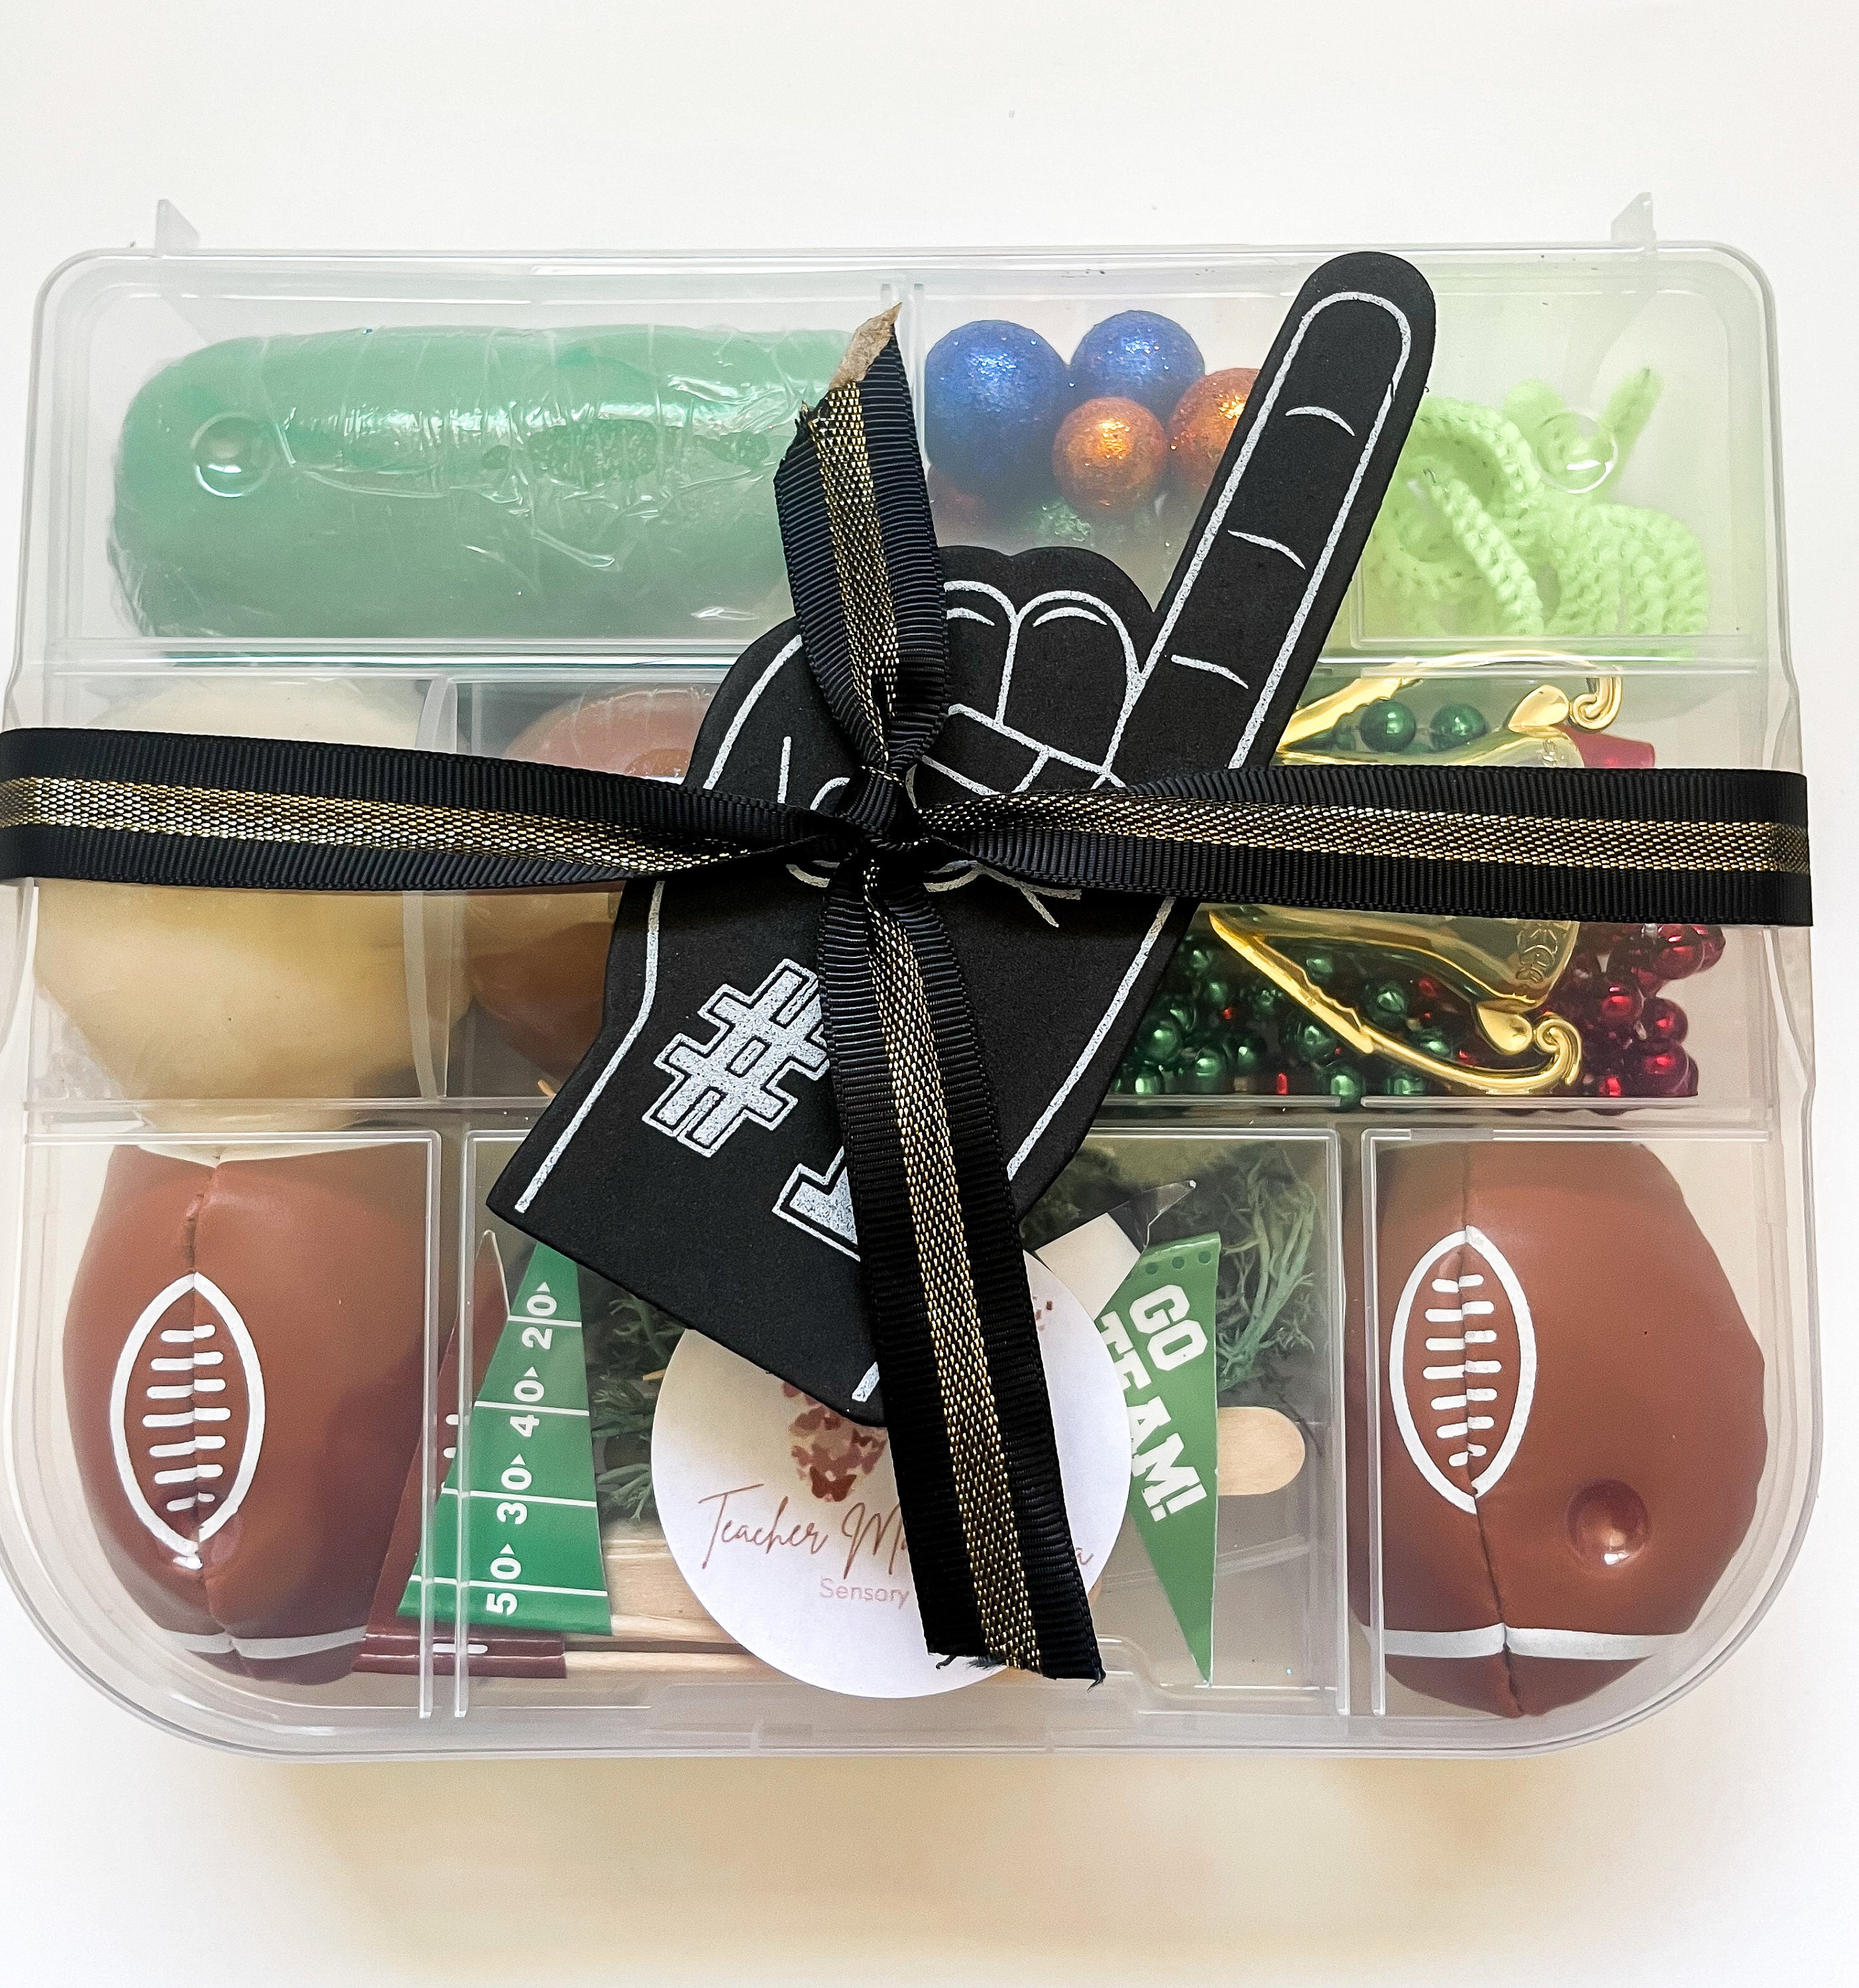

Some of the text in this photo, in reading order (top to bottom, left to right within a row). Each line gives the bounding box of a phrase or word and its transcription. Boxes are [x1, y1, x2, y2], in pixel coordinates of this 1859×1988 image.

[1129, 1284, 1208, 1371] GO
[486, 1295, 557, 1615] 50 30 40 20
[698, 1484, 830, 1569] Teacher
[820, 1579, 909, 1609] Sensory
